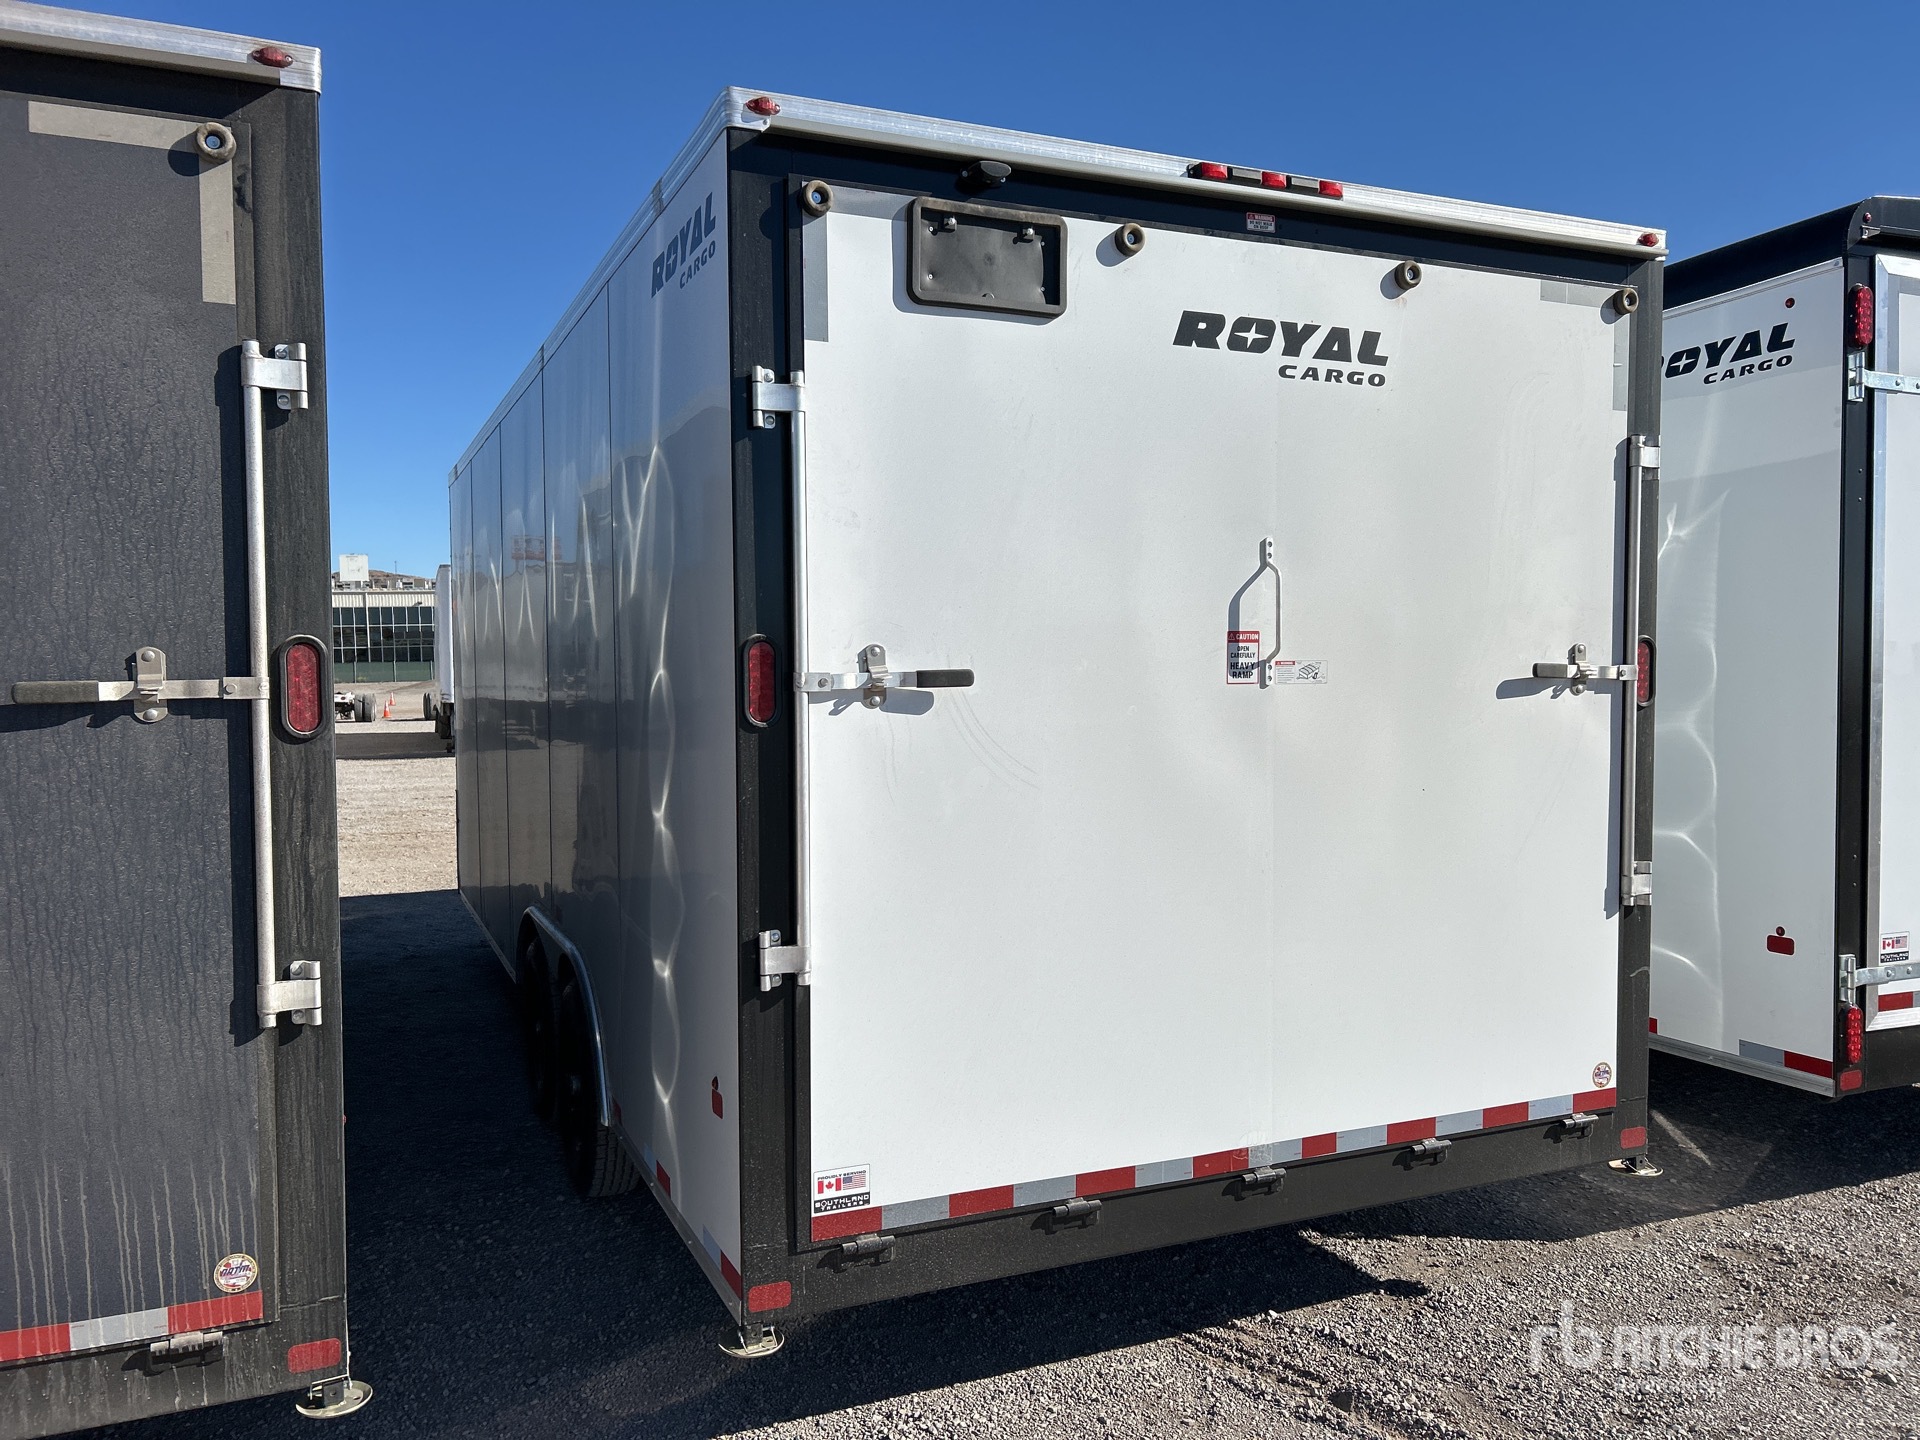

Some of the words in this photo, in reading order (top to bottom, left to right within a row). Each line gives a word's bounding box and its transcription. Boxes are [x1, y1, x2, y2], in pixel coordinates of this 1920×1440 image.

[651, 192, 716, 298] ROYAL
[680, 240, 716, 289] CARGO
[1172, 310, 1389, 367] ROYAL
[1661, 322, 1796, 379] OYAL
[1278, 364, 1386, 387] CARGO
[1703, 354, 1793, 385] CARGO
[1230, 661, 1255, 670] HEAVY
[1232, 671, 1254, 679] RAMP
[815, 1195, 869, 1208] SOUTHLAND
[821, 1201, 864, 1211] TRAILERS
